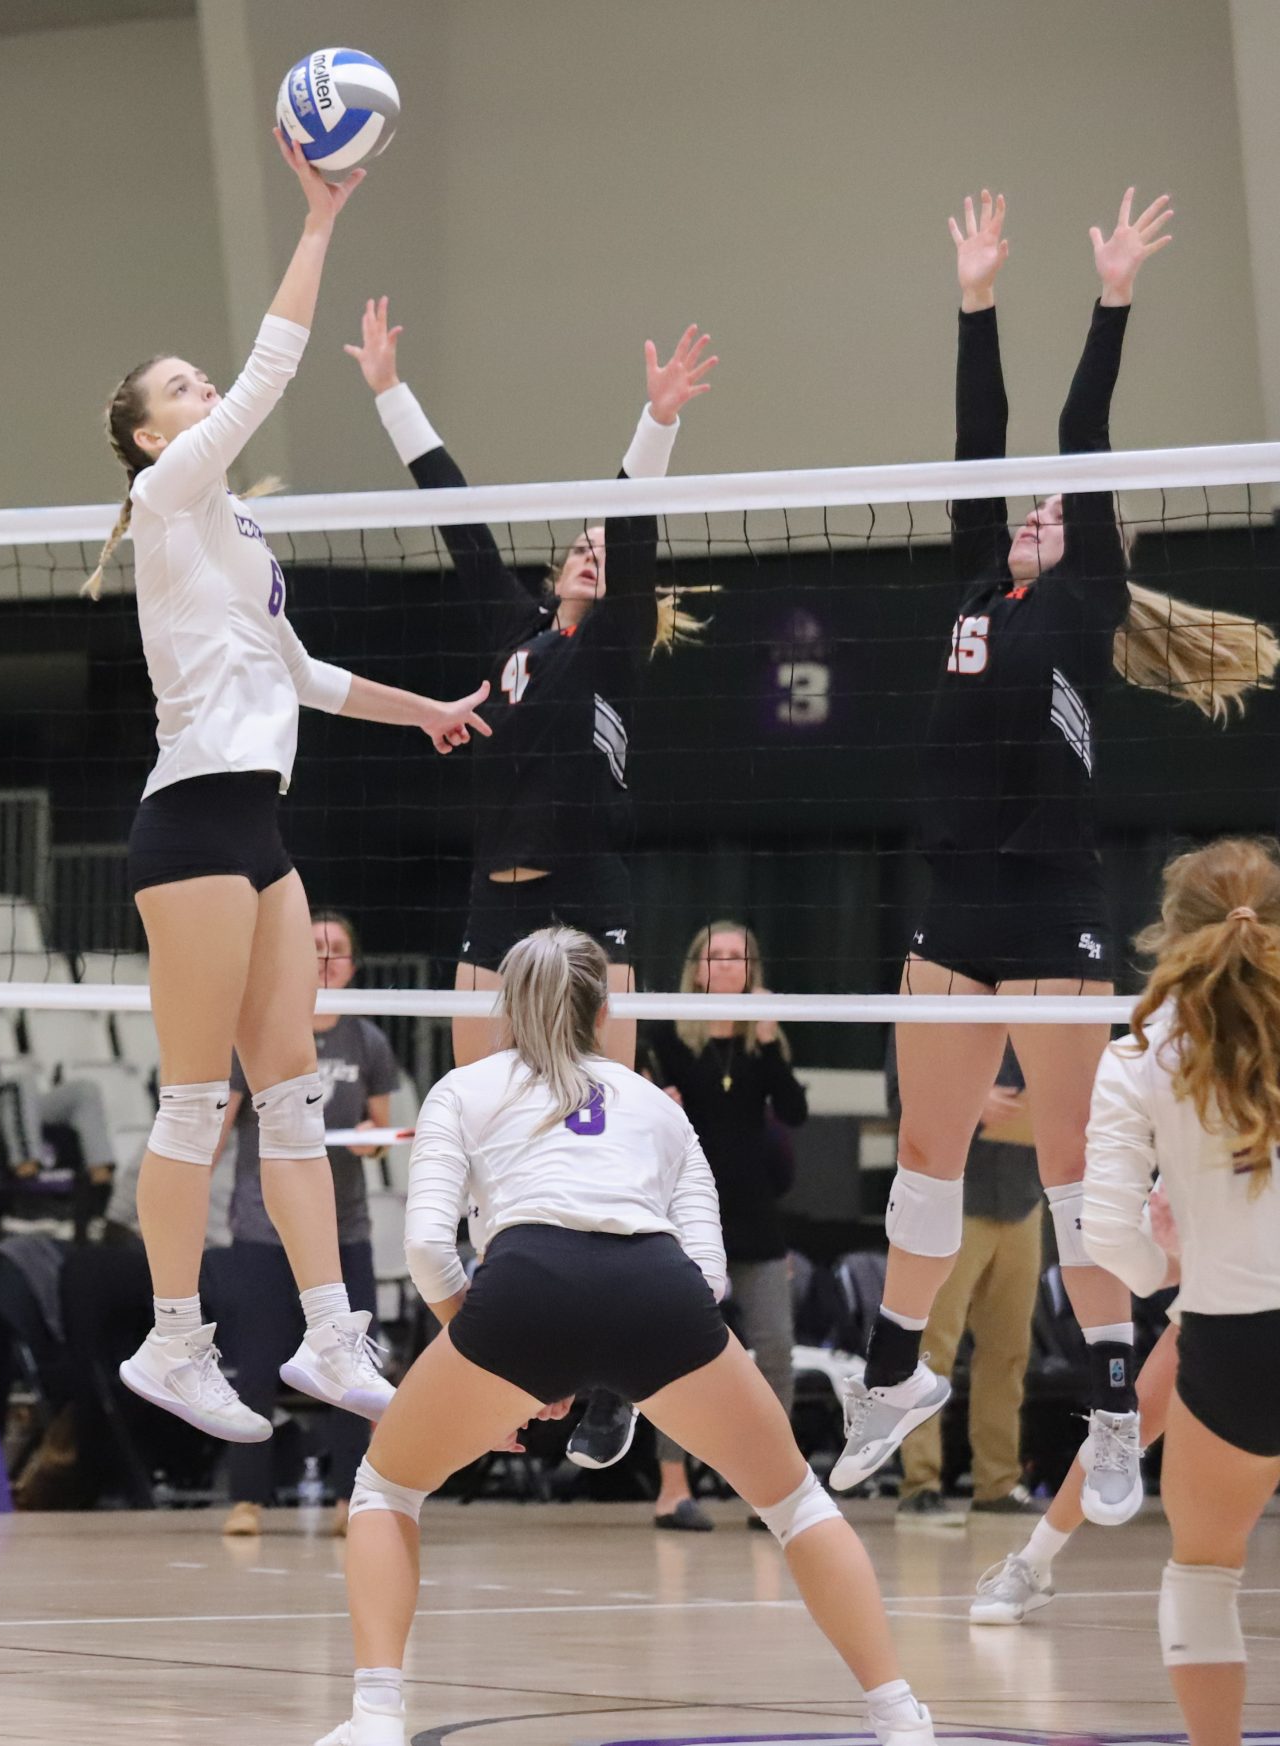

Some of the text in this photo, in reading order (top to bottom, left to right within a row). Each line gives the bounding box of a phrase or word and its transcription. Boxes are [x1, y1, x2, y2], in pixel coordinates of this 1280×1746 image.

[314, 54, 332, 110] molten
[501, 650, 529, 704] 4
[777, 662, 828, 723] 3
